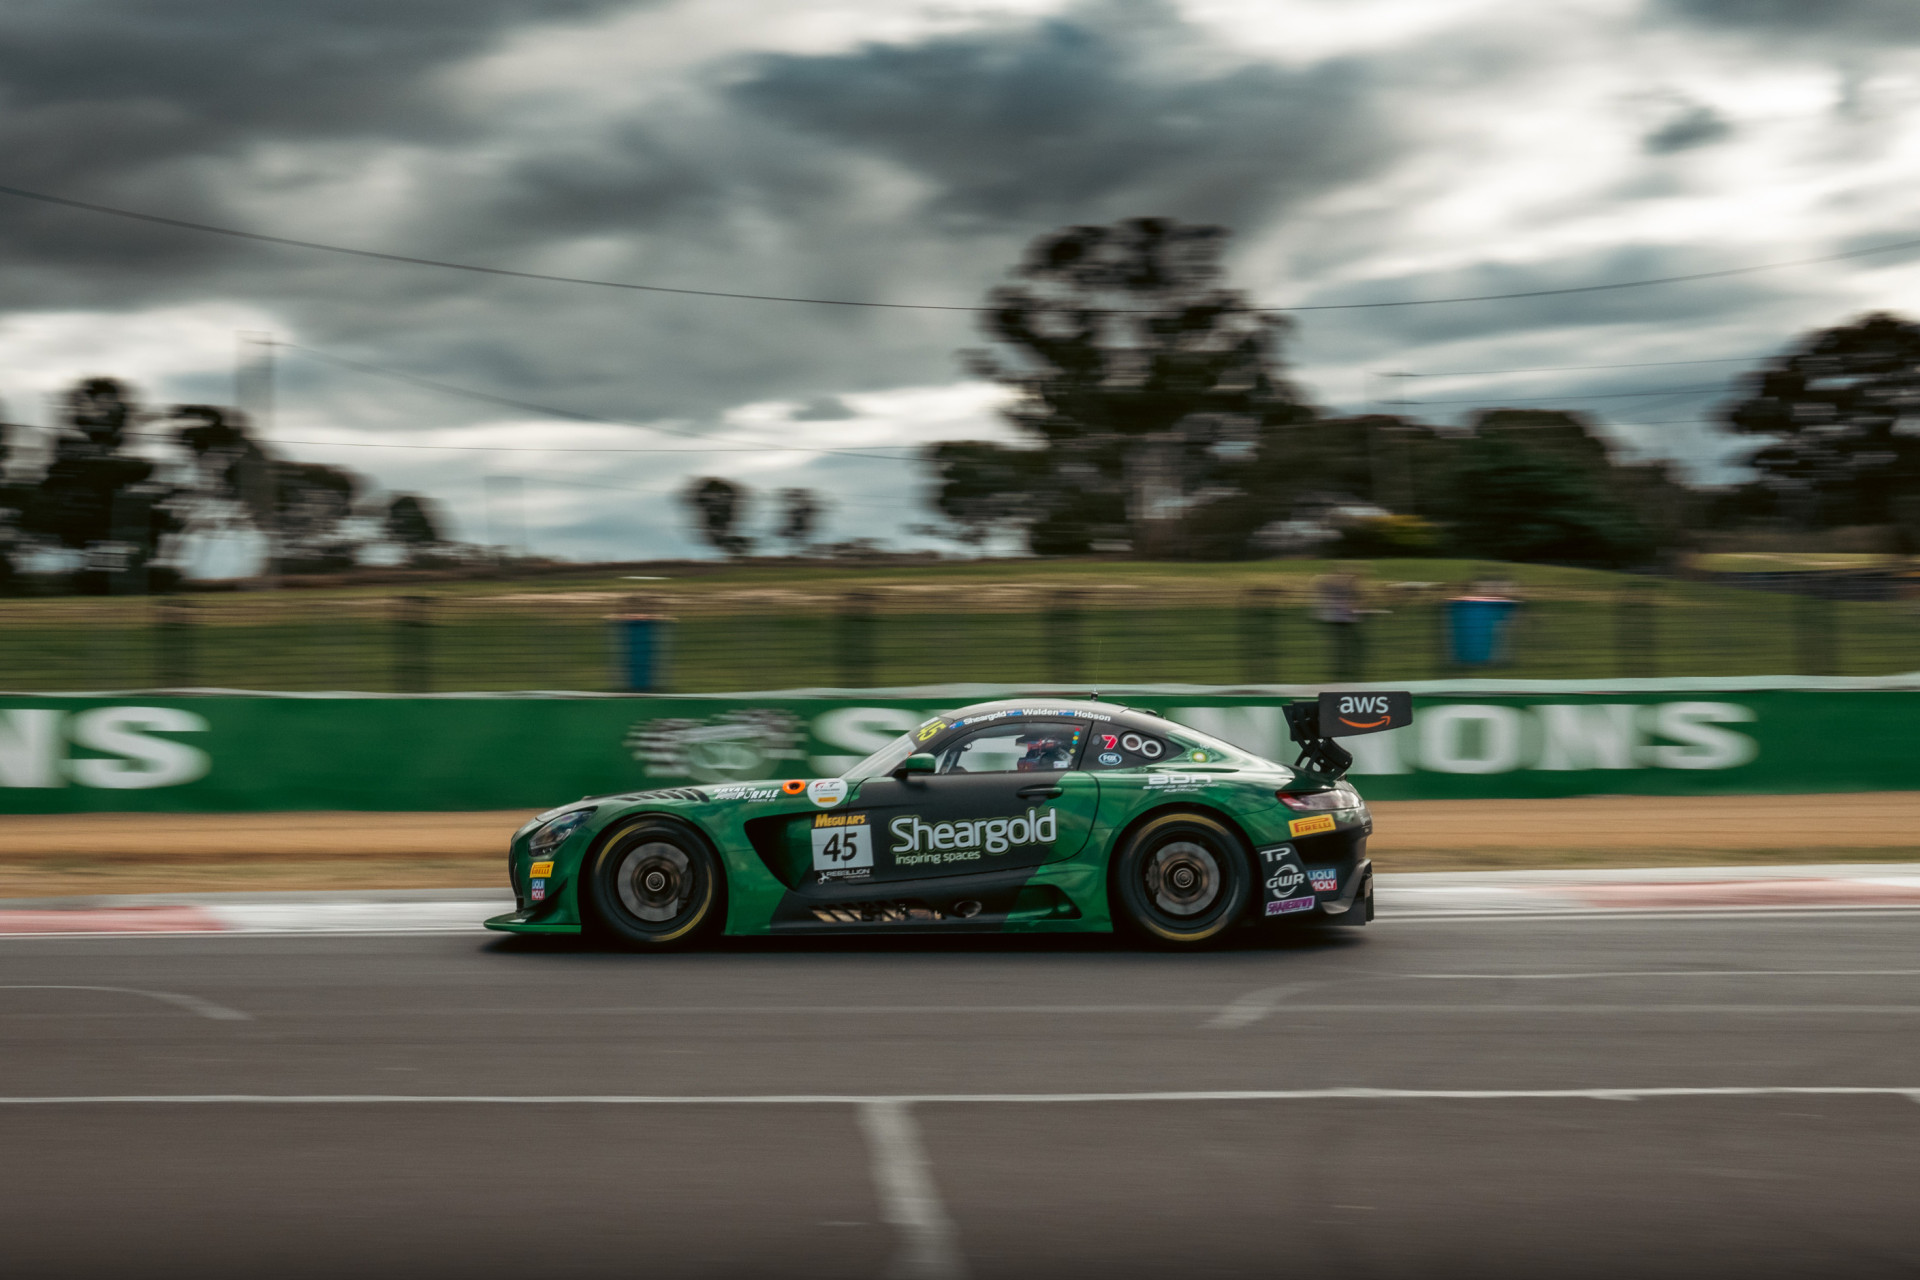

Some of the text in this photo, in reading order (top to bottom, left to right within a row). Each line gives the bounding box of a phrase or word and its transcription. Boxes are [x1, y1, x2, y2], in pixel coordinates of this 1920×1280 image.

[1339, 696, 1389, 714] aws
[963, 711, 1007, 725] Sheargold
[1074, 710, 1111, 722] Hobson
[735, 789, 780, 800] PURPLE
[891, 808, 1057, 853] Sheargold
[823, 832, 858, 862] 45
[896, 851, 981, 866] inspiring spaces
[1265, 873, 1305, 889] GWR
